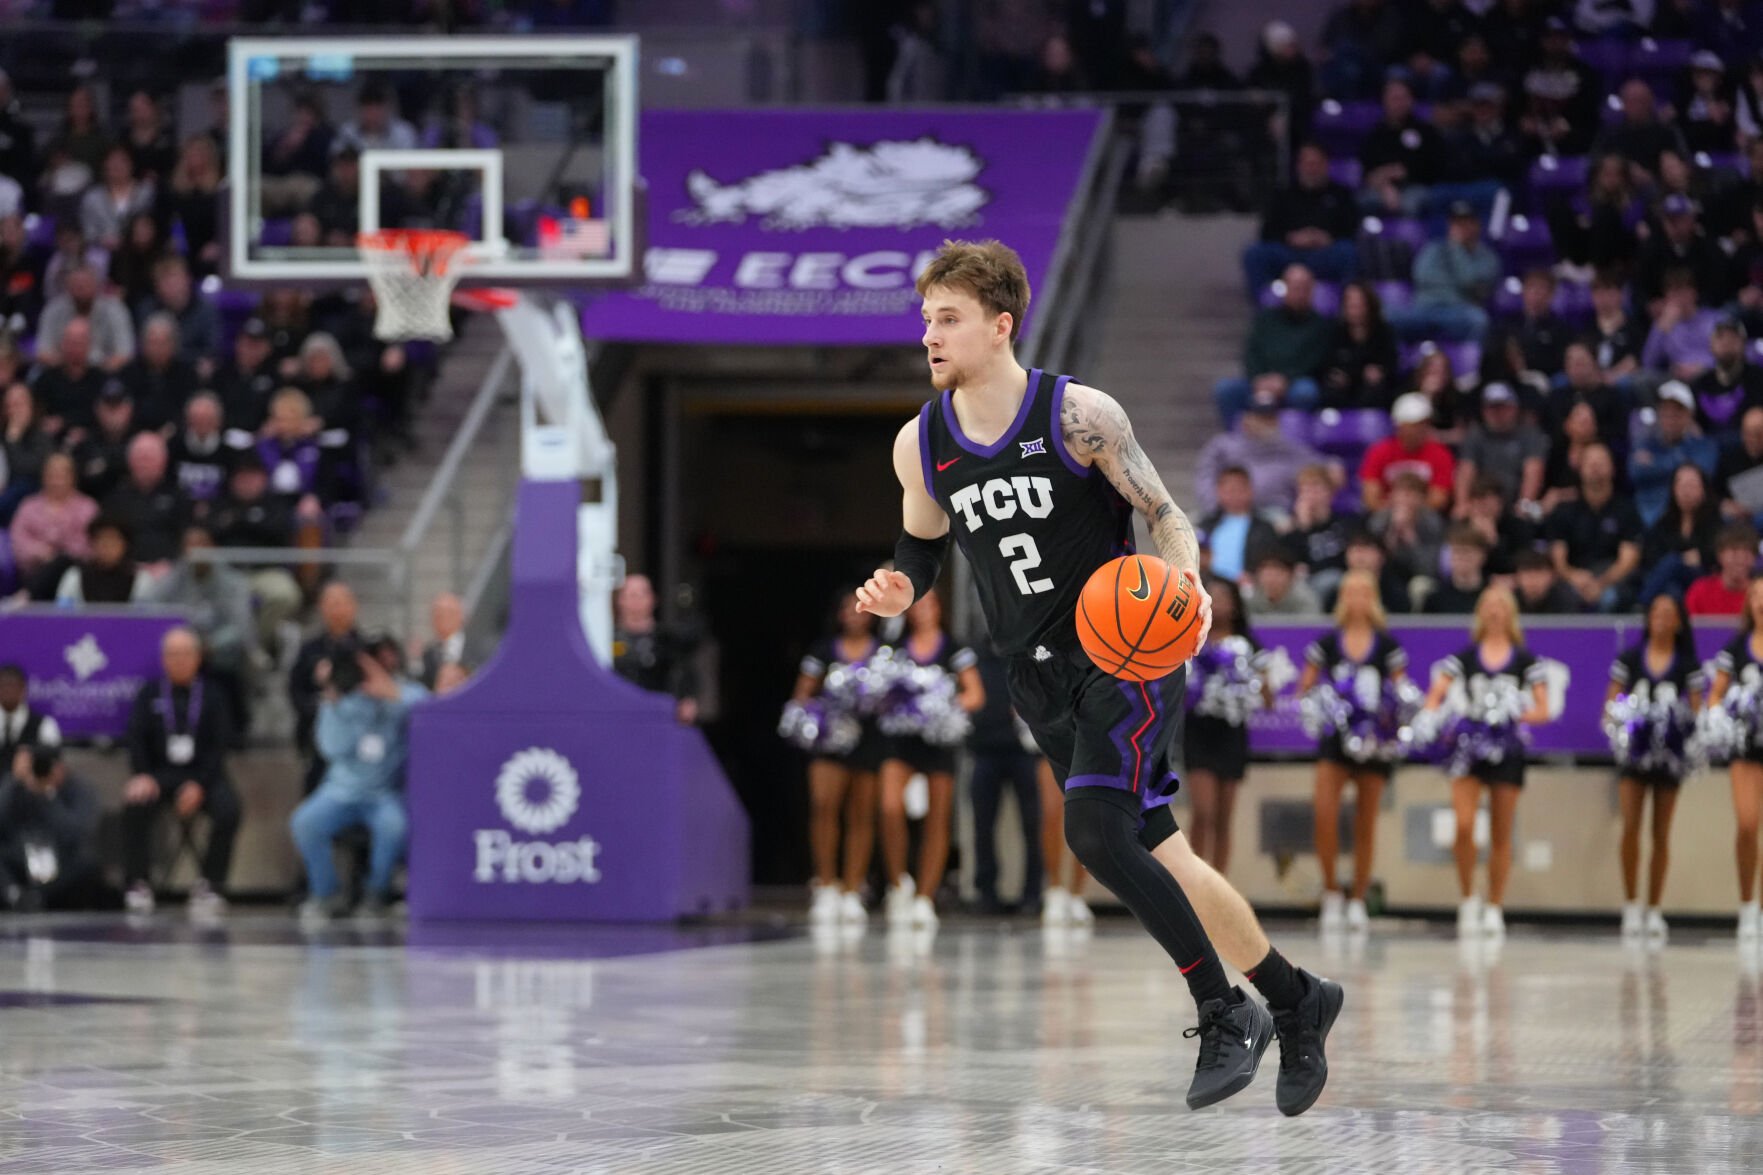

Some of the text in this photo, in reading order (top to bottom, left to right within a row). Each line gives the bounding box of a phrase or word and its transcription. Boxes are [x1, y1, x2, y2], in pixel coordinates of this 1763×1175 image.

[950, 476, 1054, 533] TCU
[998, 532, 1055, 595] 2
[473, 829, 602, 883] Frost
